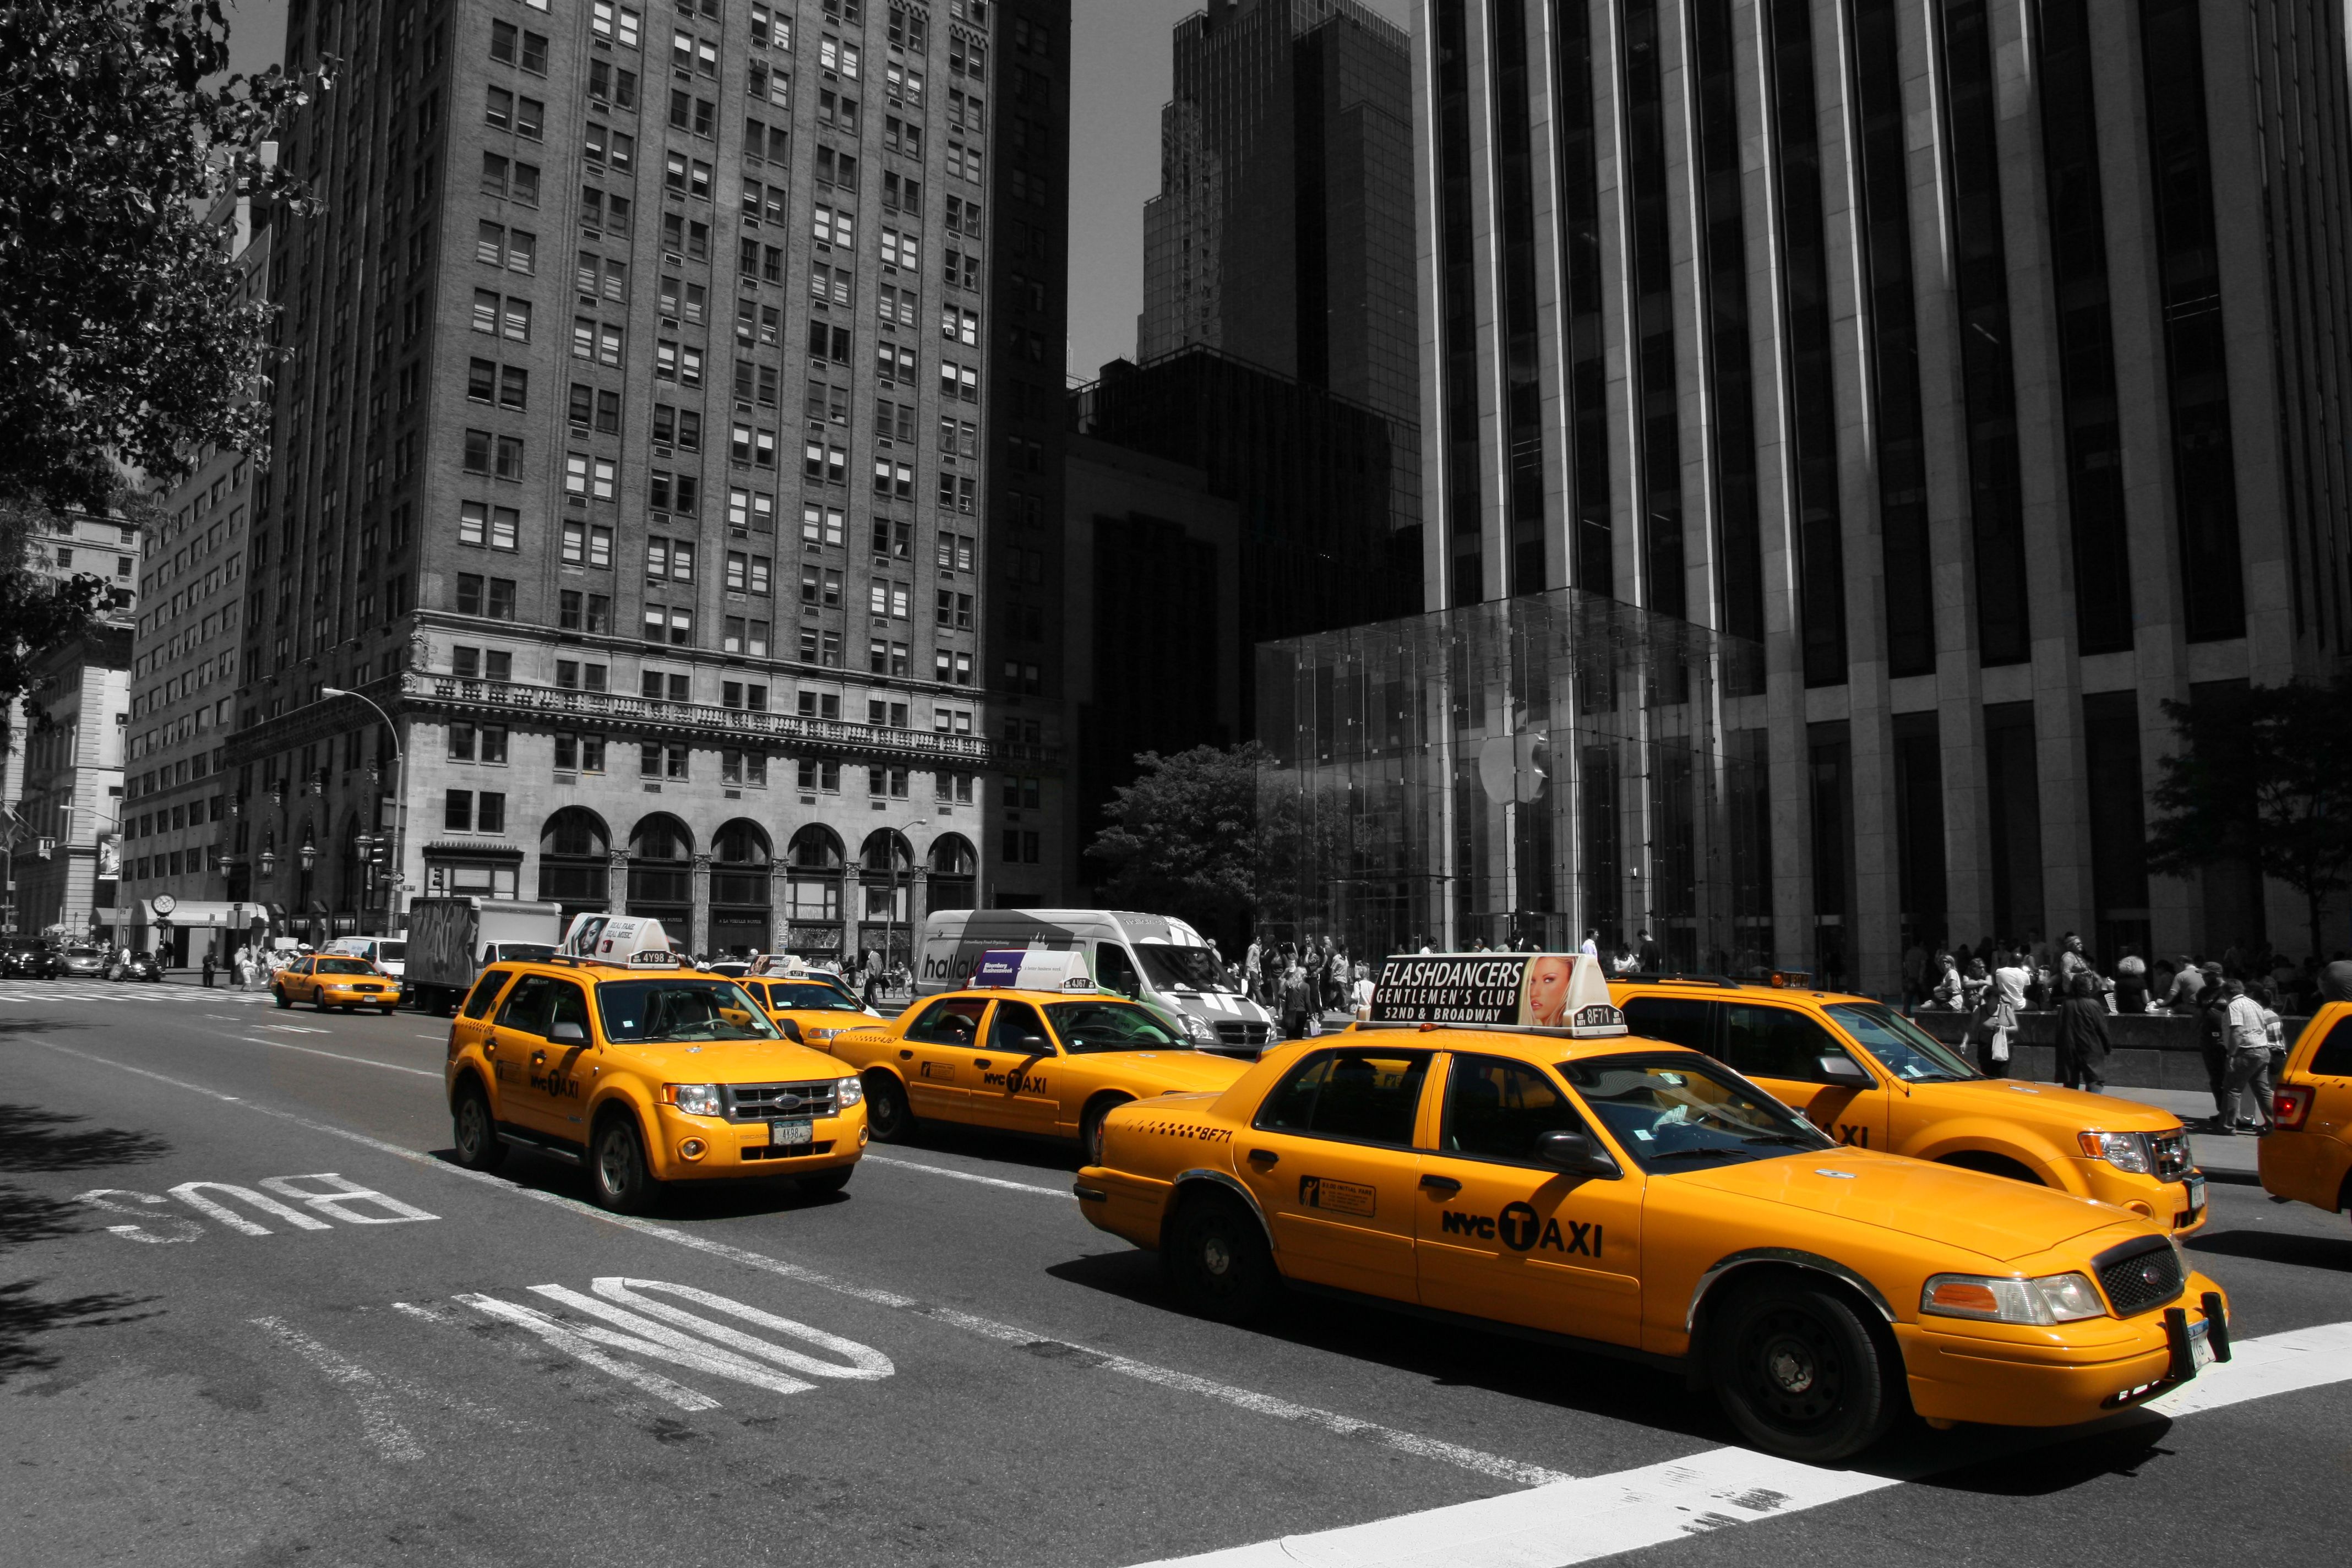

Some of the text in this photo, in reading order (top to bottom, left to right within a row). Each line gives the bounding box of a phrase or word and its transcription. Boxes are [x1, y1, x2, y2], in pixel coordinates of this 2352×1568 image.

[643, 953, 664, 962] 4Y98
[1072, 979, 1086, 988] 4J67
[1380, 962, 1523, 987] FLASHDANCERS
[1376, 988, 1515, 1006] GENTLEMEN'S CLUB
[1385, 1007, 1501, 1022] 52ND & BROADWAY
[1587, 1008, 1609, 1024] 8F71
[531, 1069, 579, 1099] NYC TAXI
[984, 1069, 1047, 1094] NYC TAXI
[1199, 1127, 1233, 1144] 8F71
[1823, 1123, 1869, 1148] AXI
[72, 1173, 442, 1243] BUS
[1442, 1201, 1602, 1258] NYC TAXI
